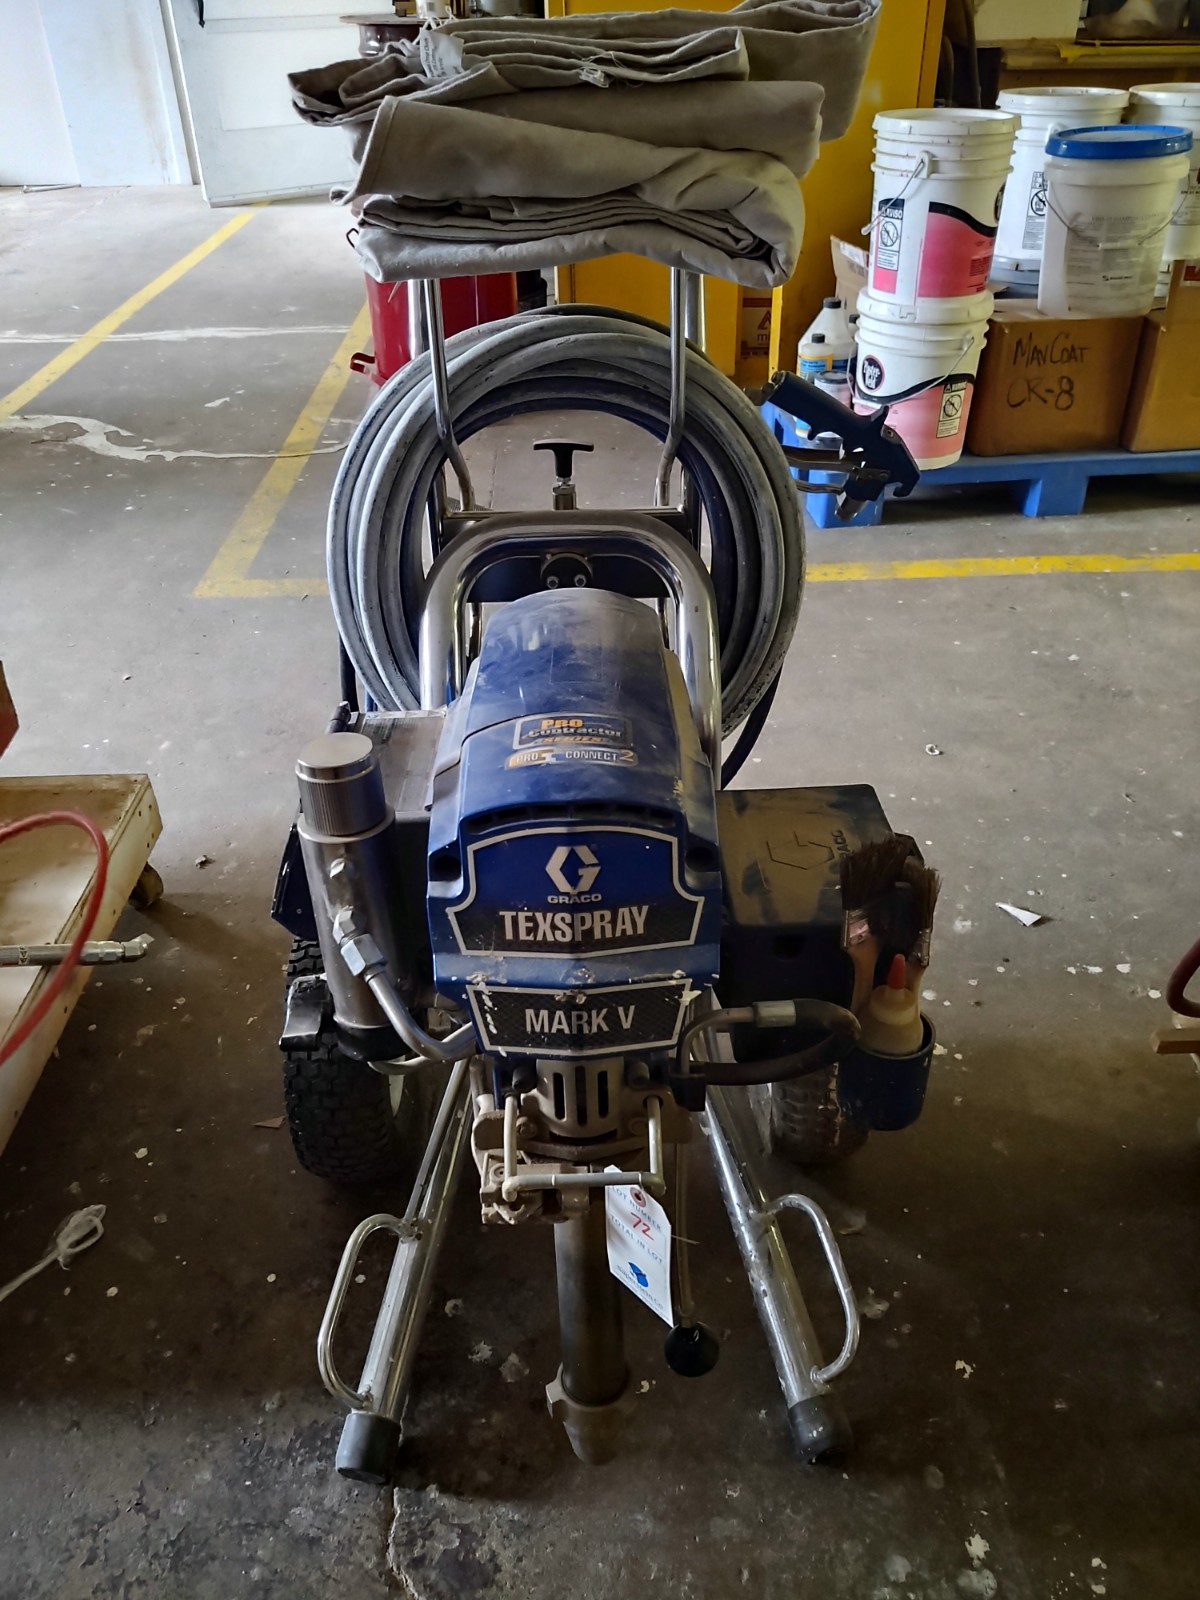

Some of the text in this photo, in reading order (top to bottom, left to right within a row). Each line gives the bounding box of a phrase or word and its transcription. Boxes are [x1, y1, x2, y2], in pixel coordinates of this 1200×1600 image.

[527, 726, 623, 738] Contractor
[541, 718, 584, 730] PRO
[516, 749, 635, 763] PRO CONNECT 2
[547, 893, 602, 904] GRACO
[499, 907, 650, 943] TEXSPRAY
[525, 1005, 636, 1035] MARK V
[610, 1214, 634, 1240] TOTAL
[629, 1199, 662, 1232] NUMBER
[630, 1211, 655, 1241] 72
